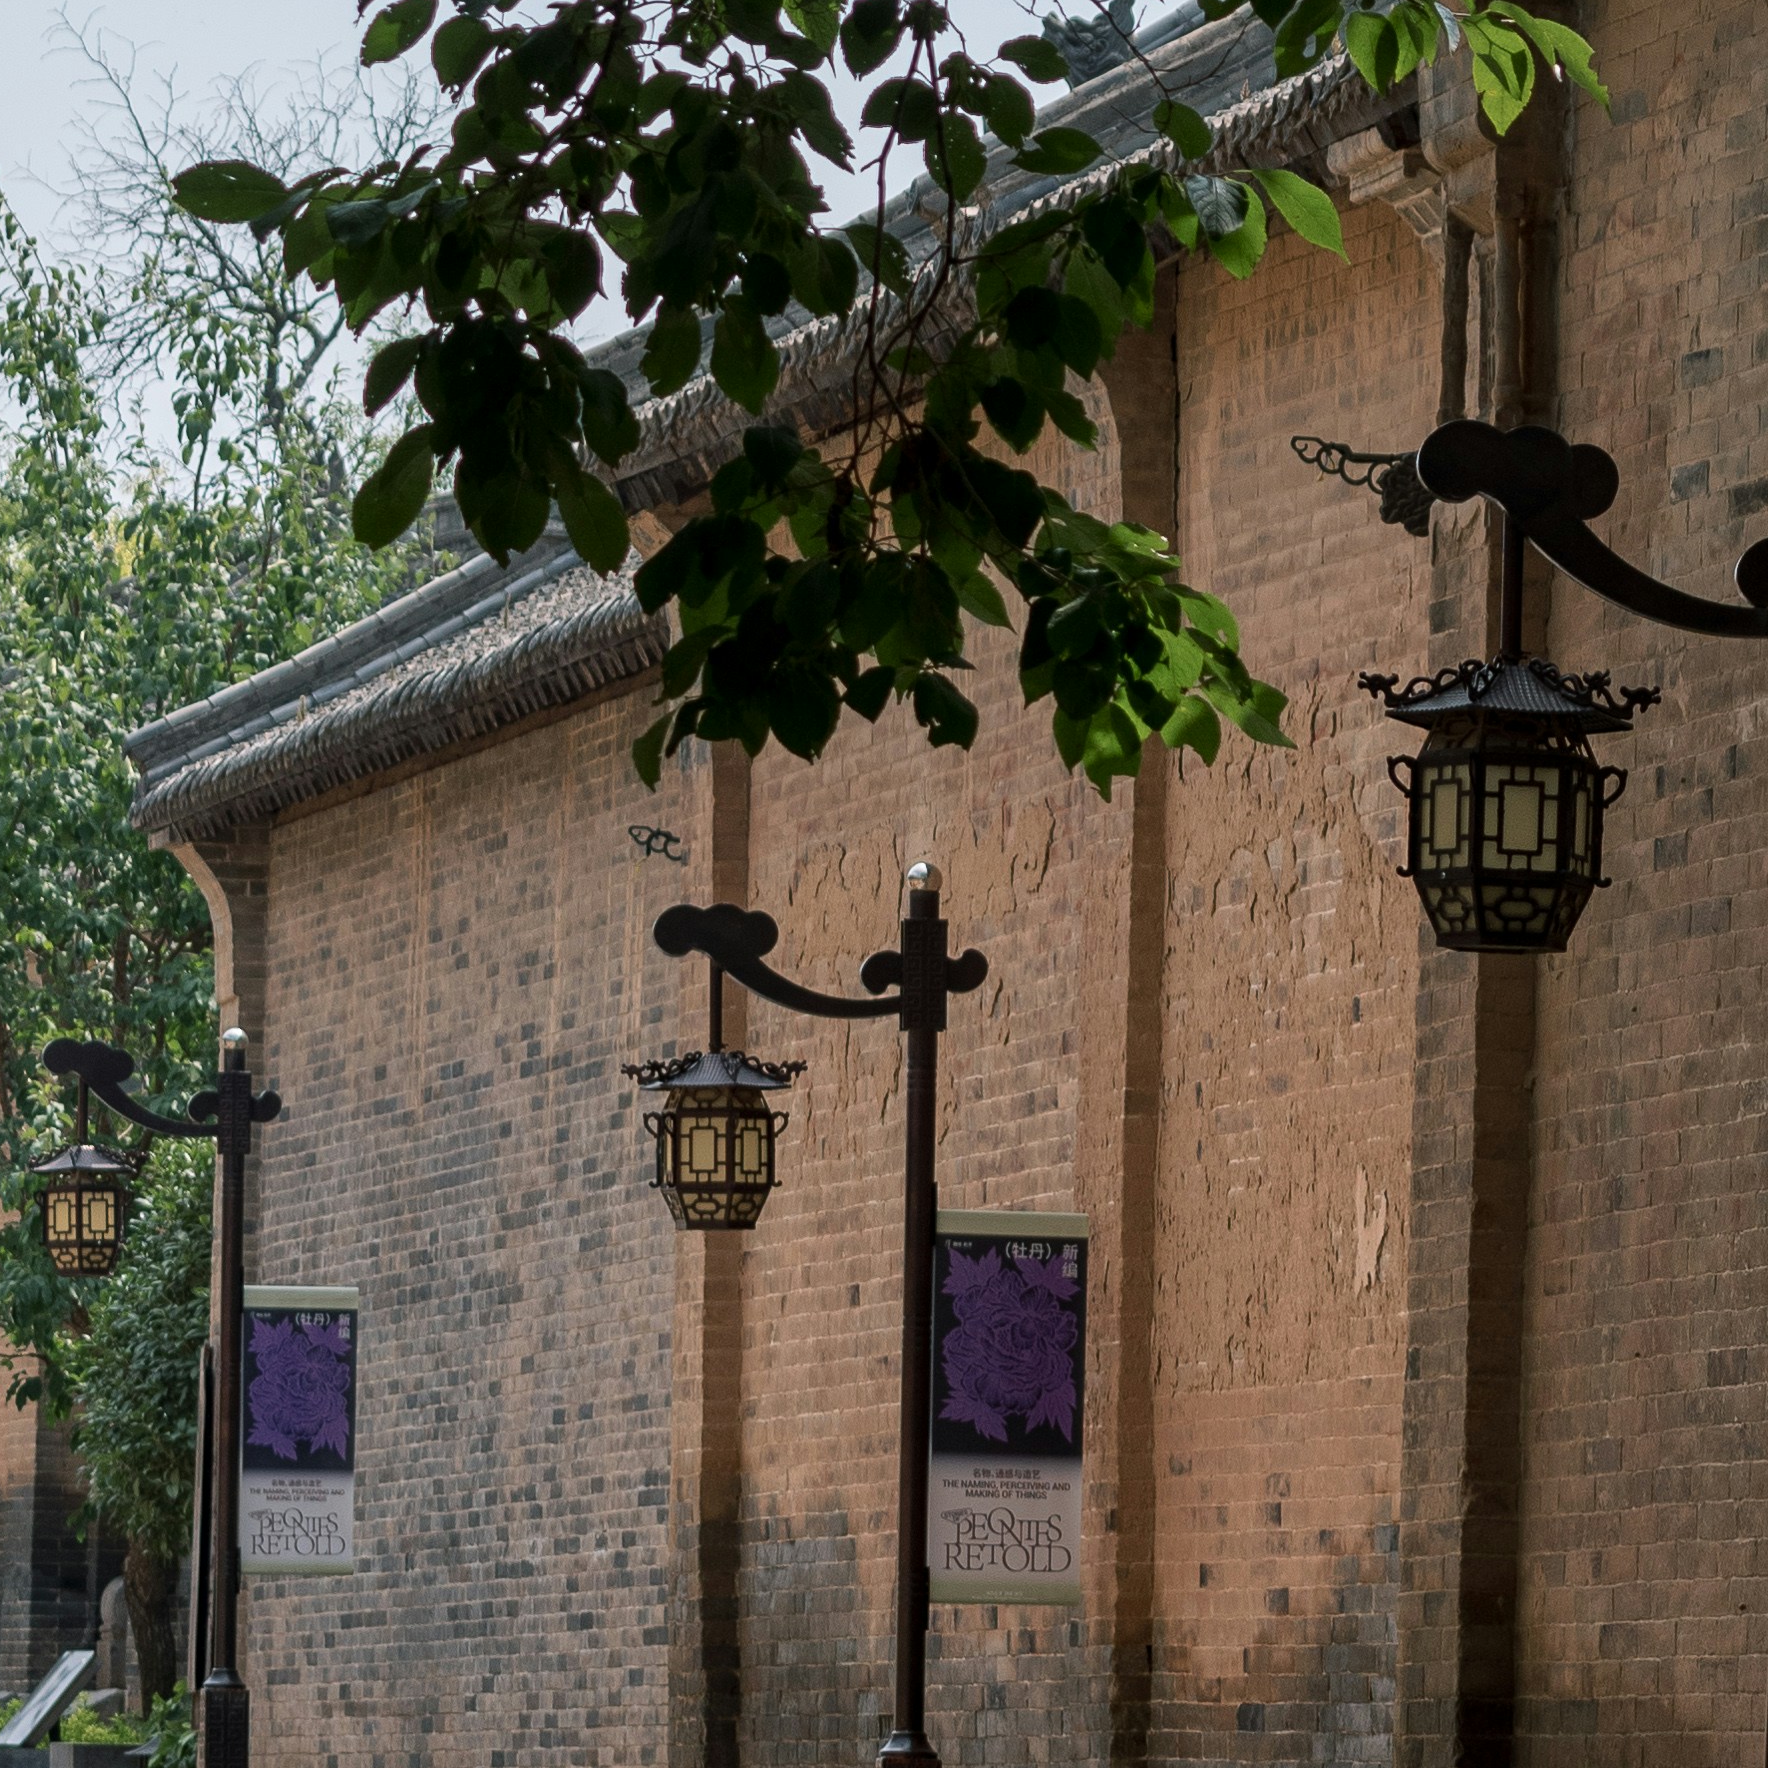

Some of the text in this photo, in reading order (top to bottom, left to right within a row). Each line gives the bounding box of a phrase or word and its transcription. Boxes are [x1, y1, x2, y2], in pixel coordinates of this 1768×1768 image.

[942, 1479, 1071, 1491] THE NAMING, PERCEIVING AND
[965, 1489, 1047, 1500] MAKING OF THINGS
[259, 1507, 339, 1537] PEONIES
[956, 1507, 1062, 1548] PEONIES
[251, 1534, 346, 1556] RETOLD
[943, 1542, 1072, 1572] RETOLD
